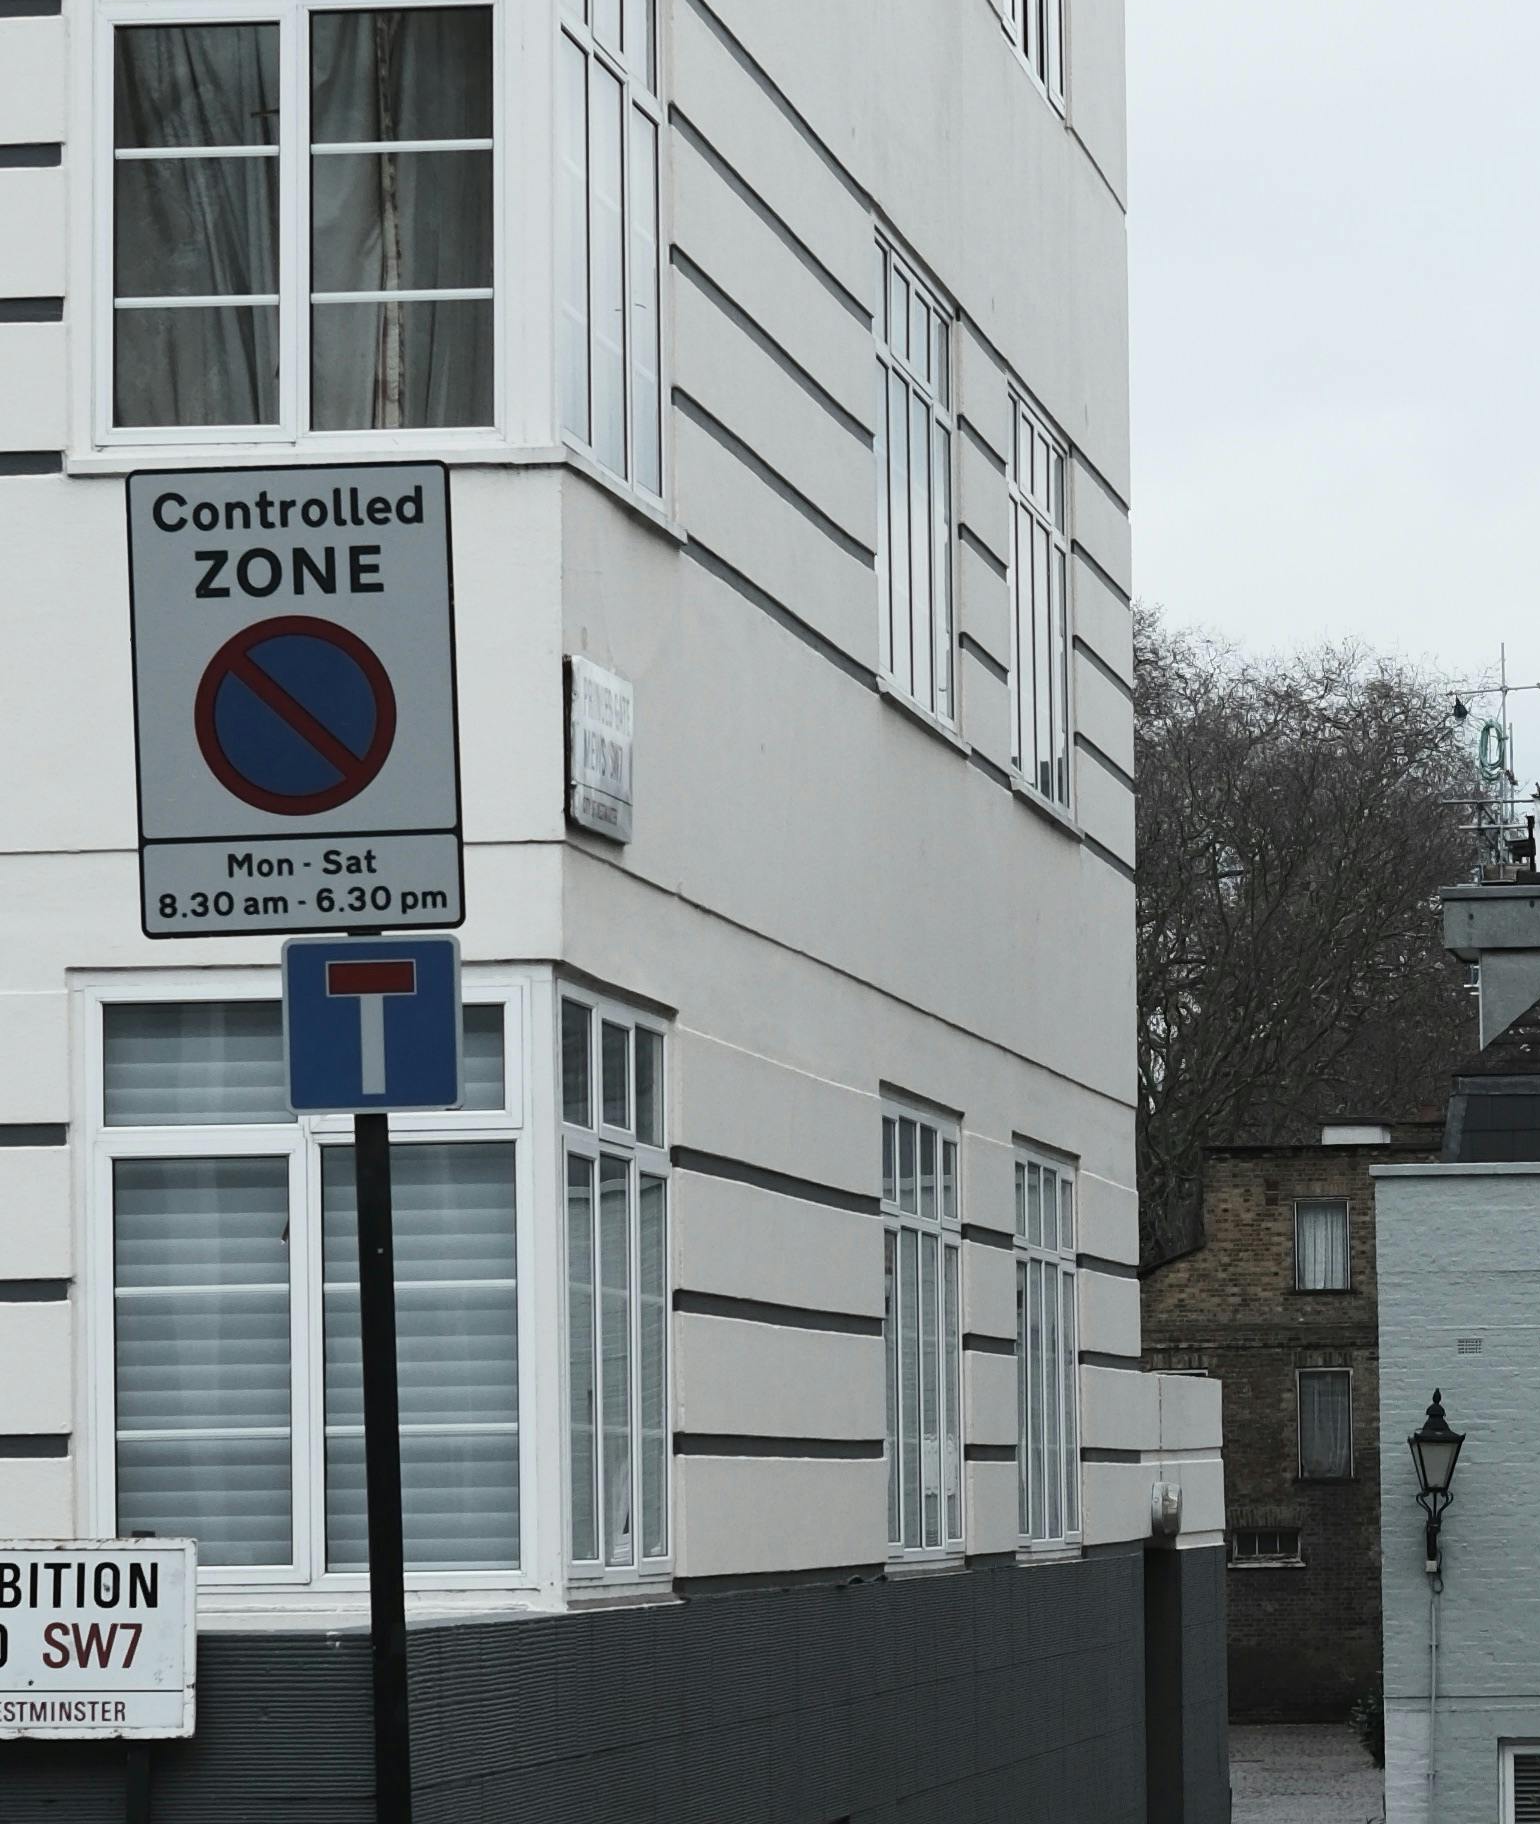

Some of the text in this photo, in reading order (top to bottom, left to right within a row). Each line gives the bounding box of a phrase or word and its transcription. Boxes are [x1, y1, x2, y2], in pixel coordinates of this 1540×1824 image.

[152, 484, 424, 533] Controlled
[194, 544, 386, 599] ZONE
[227, 852, 294, 878] Mon
[322, 849, 377, 875] Sat
[159, 890, 235, 919] 8.30
[244, 894, 288, 916] am
[316, 885, 391, 914] 6.30
[401, 889, 448, 920] pm
[42, 1621, 143, 1669] SW7
[0, 1701, 126, 1723] STMINSTER
